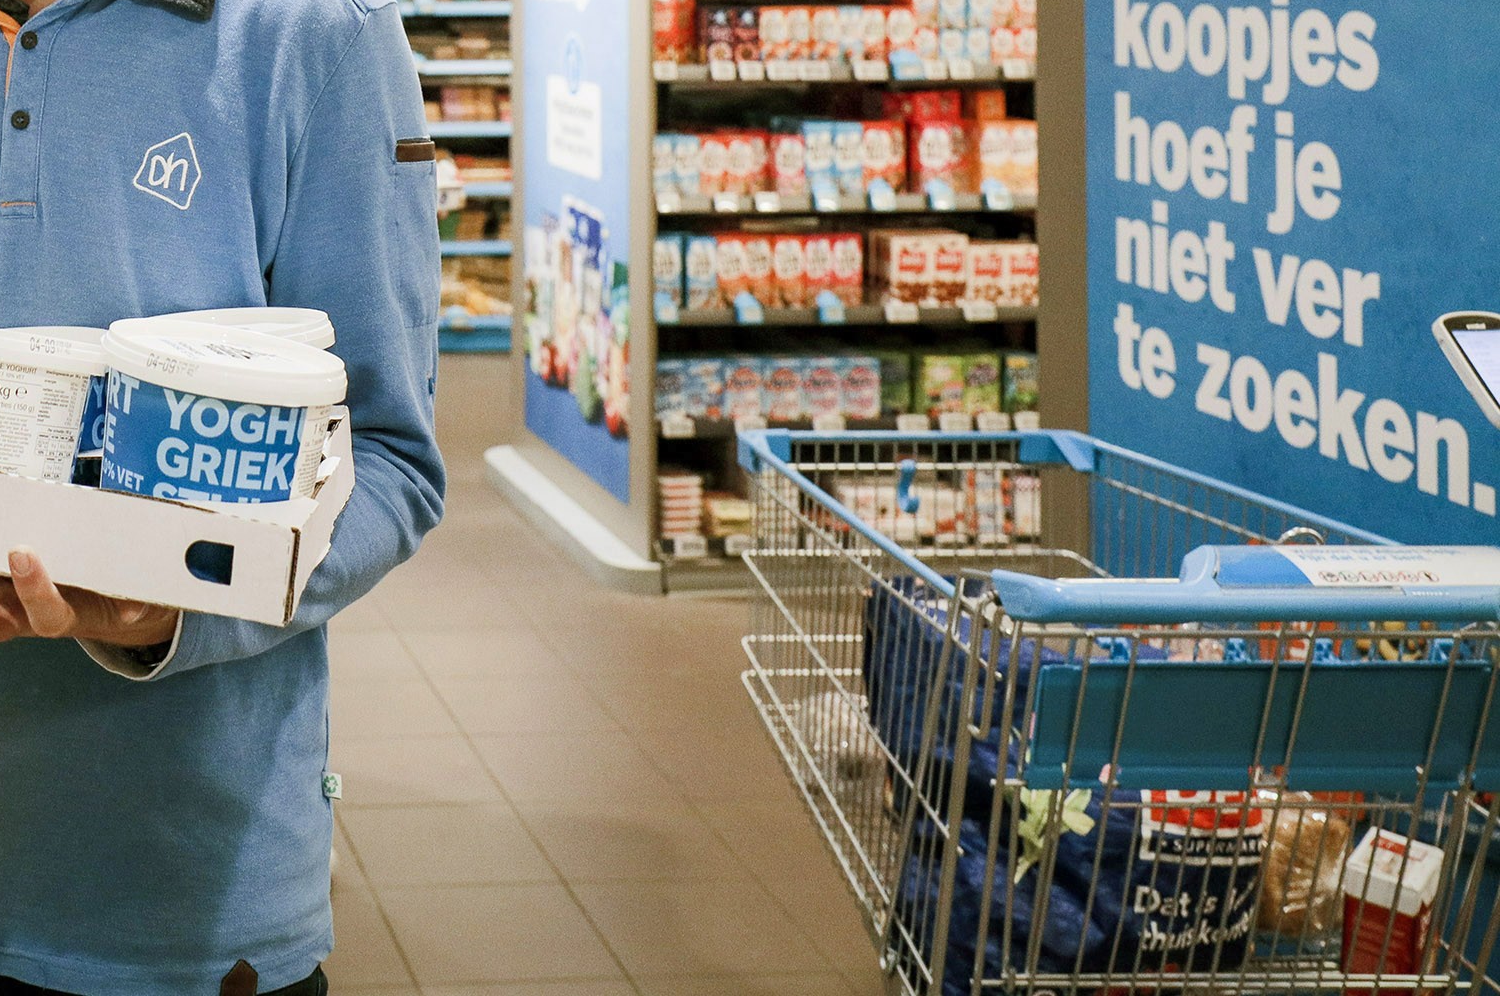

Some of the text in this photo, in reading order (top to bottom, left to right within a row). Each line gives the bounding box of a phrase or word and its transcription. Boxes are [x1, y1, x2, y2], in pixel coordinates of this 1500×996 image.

[1114, 91, 1342, 235] hoef je
[1115, 200, 1381, 347] niet ver
[6, 363, 38, 375] YOGHURT
[1114, 303, 1497, 517] te zoeken.
[117, 465, 144, 492] VET
[156, 436, 298, 491] GRIEK
[1133, 885, 1190, 918] Dat
